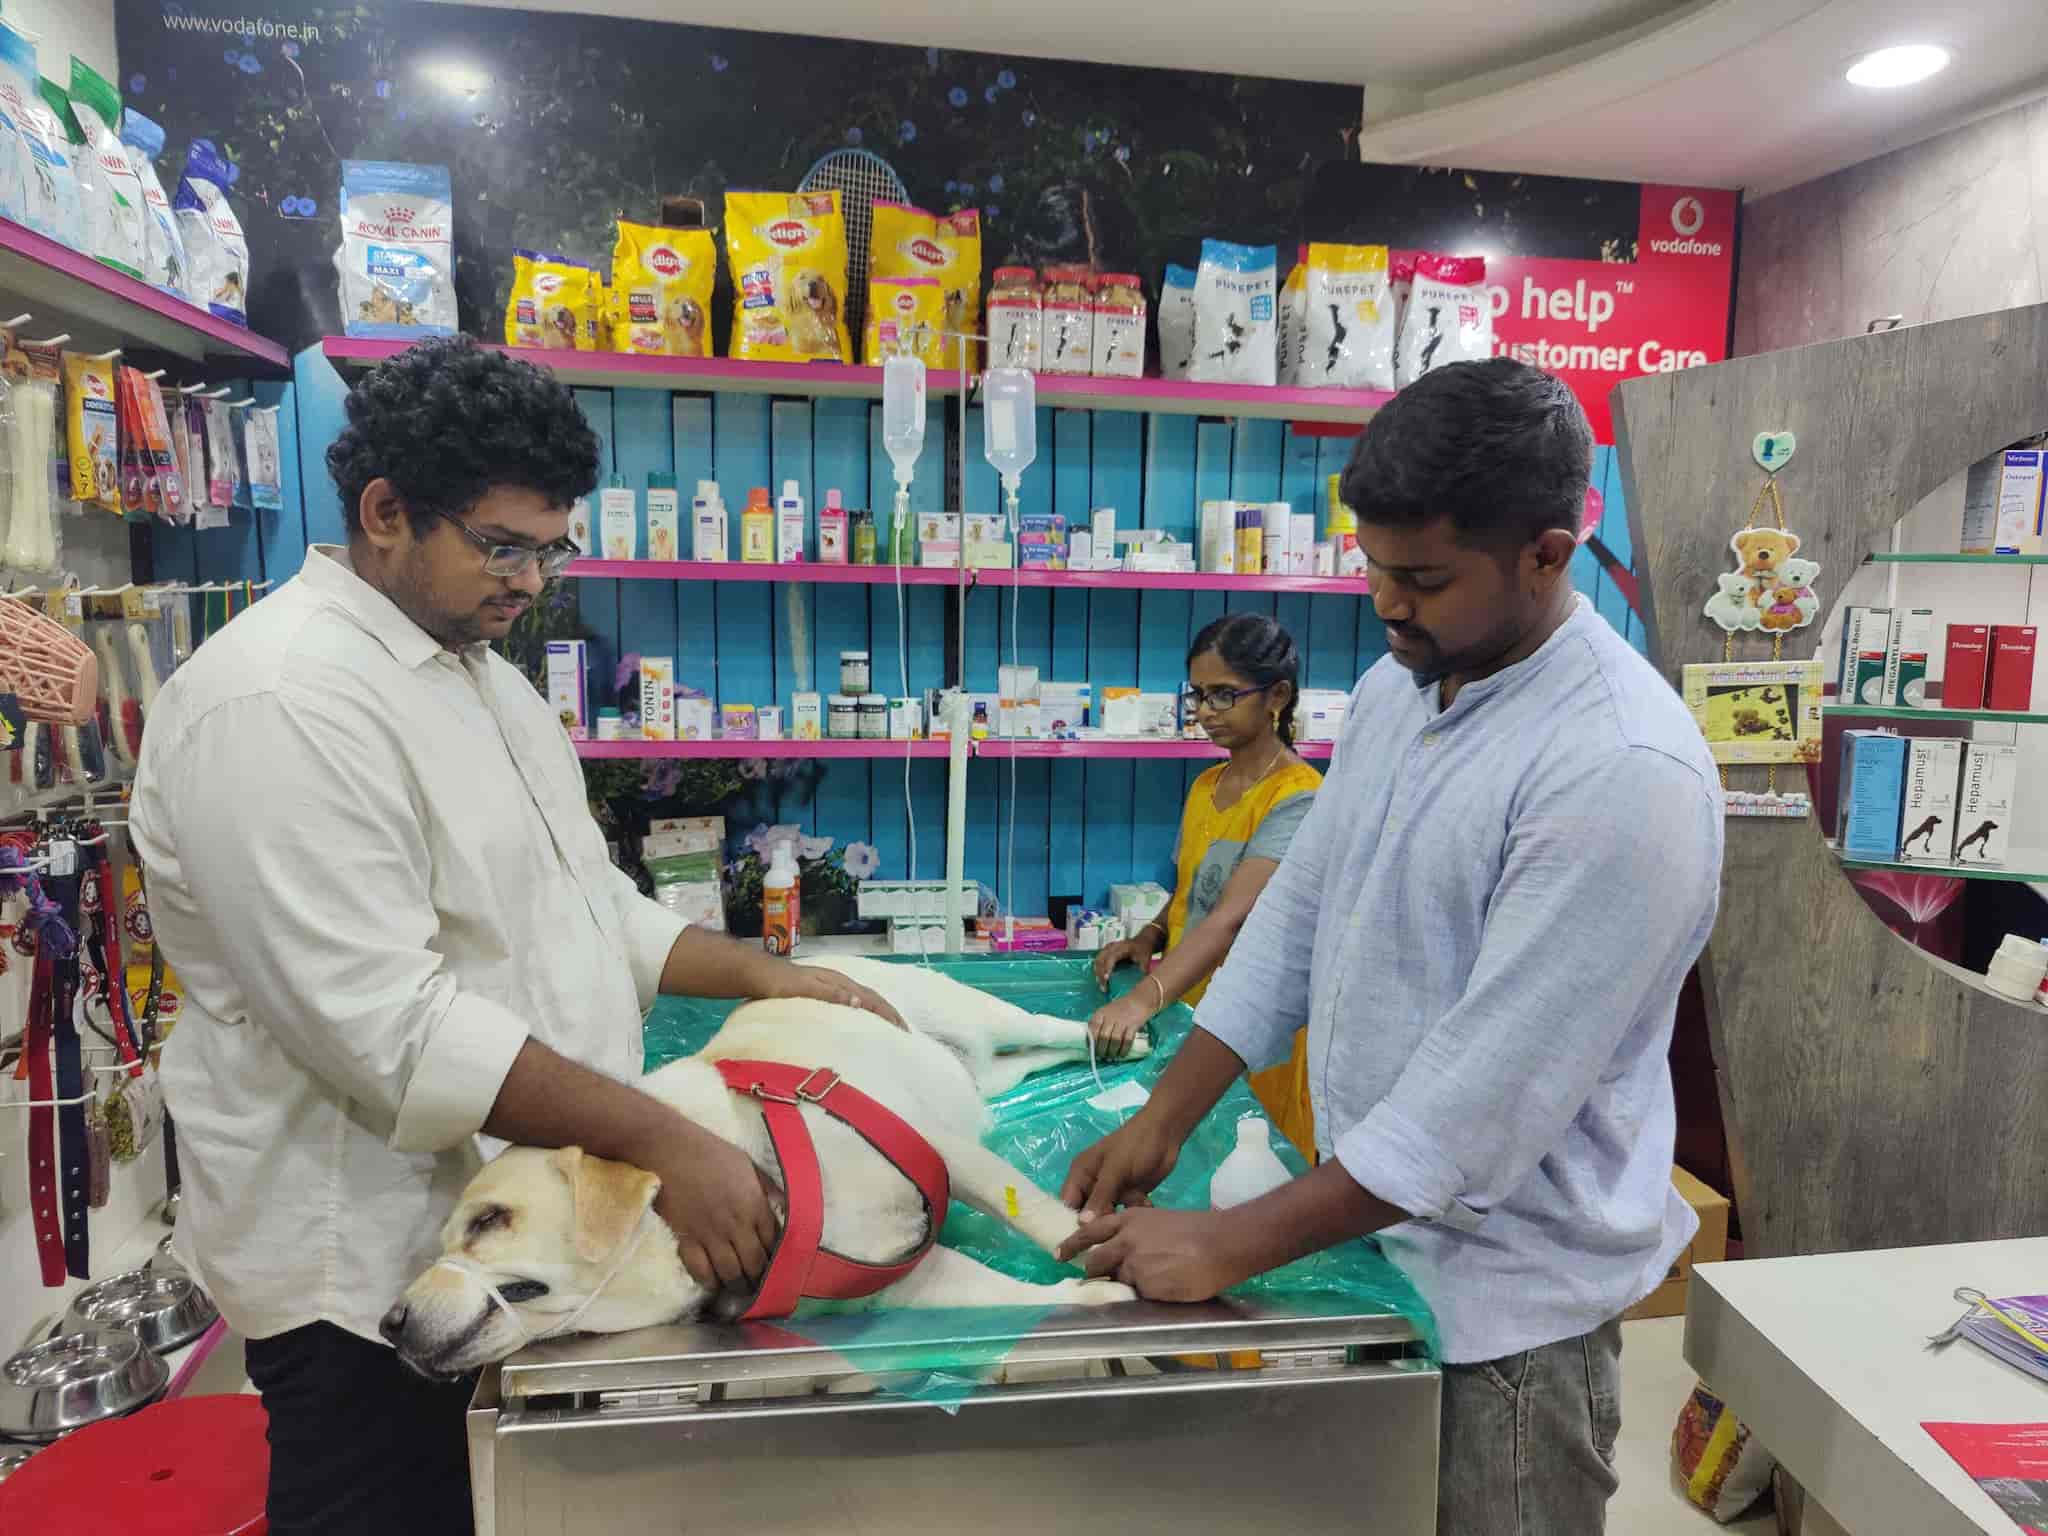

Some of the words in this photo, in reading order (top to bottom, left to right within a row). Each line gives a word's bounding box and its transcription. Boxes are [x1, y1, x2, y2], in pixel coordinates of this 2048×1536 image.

[163, 15, 319, 41] www.vodafone.in
[358, 222, 397, 238] ROYAL
[401, 226, 441, 239] CANIN
[1650, 238, 1722, 256] vodafone
[1486, 284, 1510, 319] o
[1521, 276, 1615, 333] help
[1638, 340, 1708, 373] Care
[644, 680, 655, 722] TONIN
[1911, 749, 1928, 808] Hepamust
[1967, 752, 1984, 813] Hepamust
